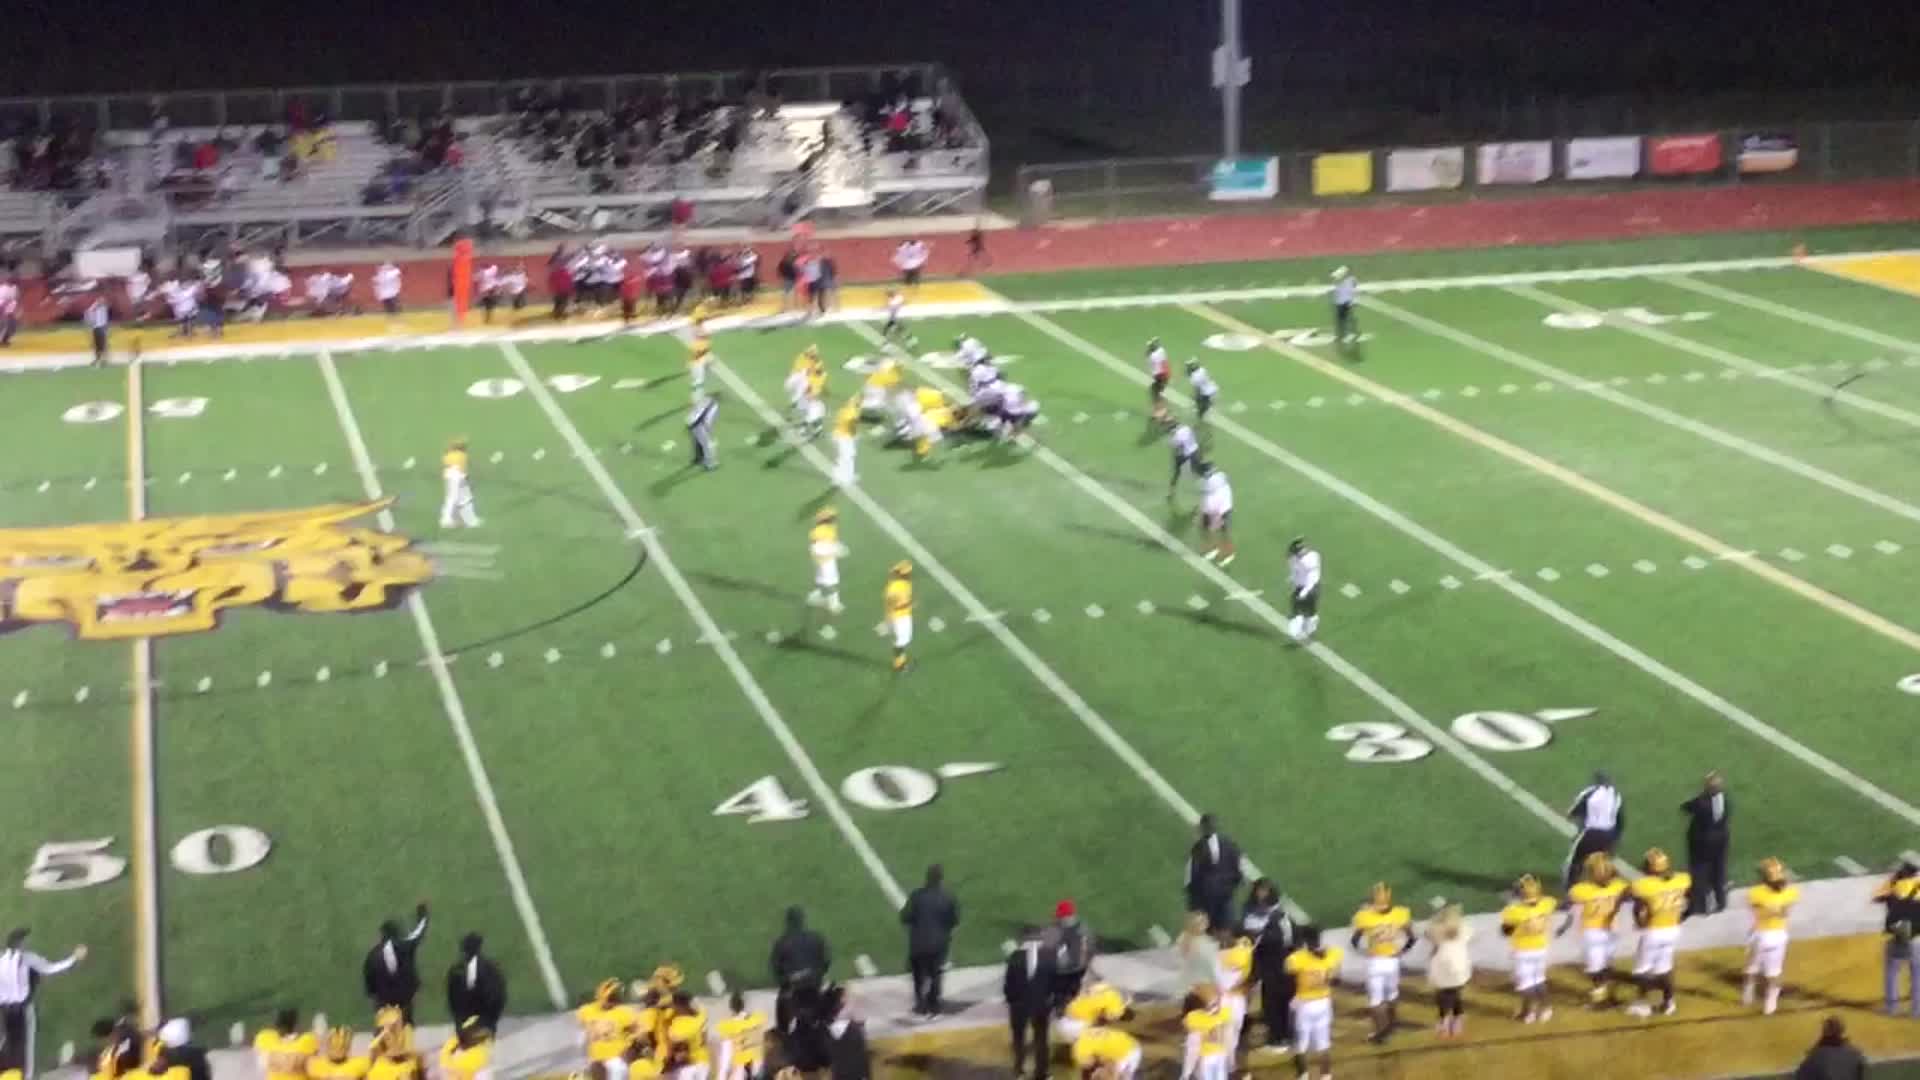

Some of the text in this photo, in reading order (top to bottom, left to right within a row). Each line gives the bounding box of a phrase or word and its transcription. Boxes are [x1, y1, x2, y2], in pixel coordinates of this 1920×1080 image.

[1326, 711, 1552, 763] 30
[711, 764, 937, 825] 40
[23, 823, 270, 893] 50
